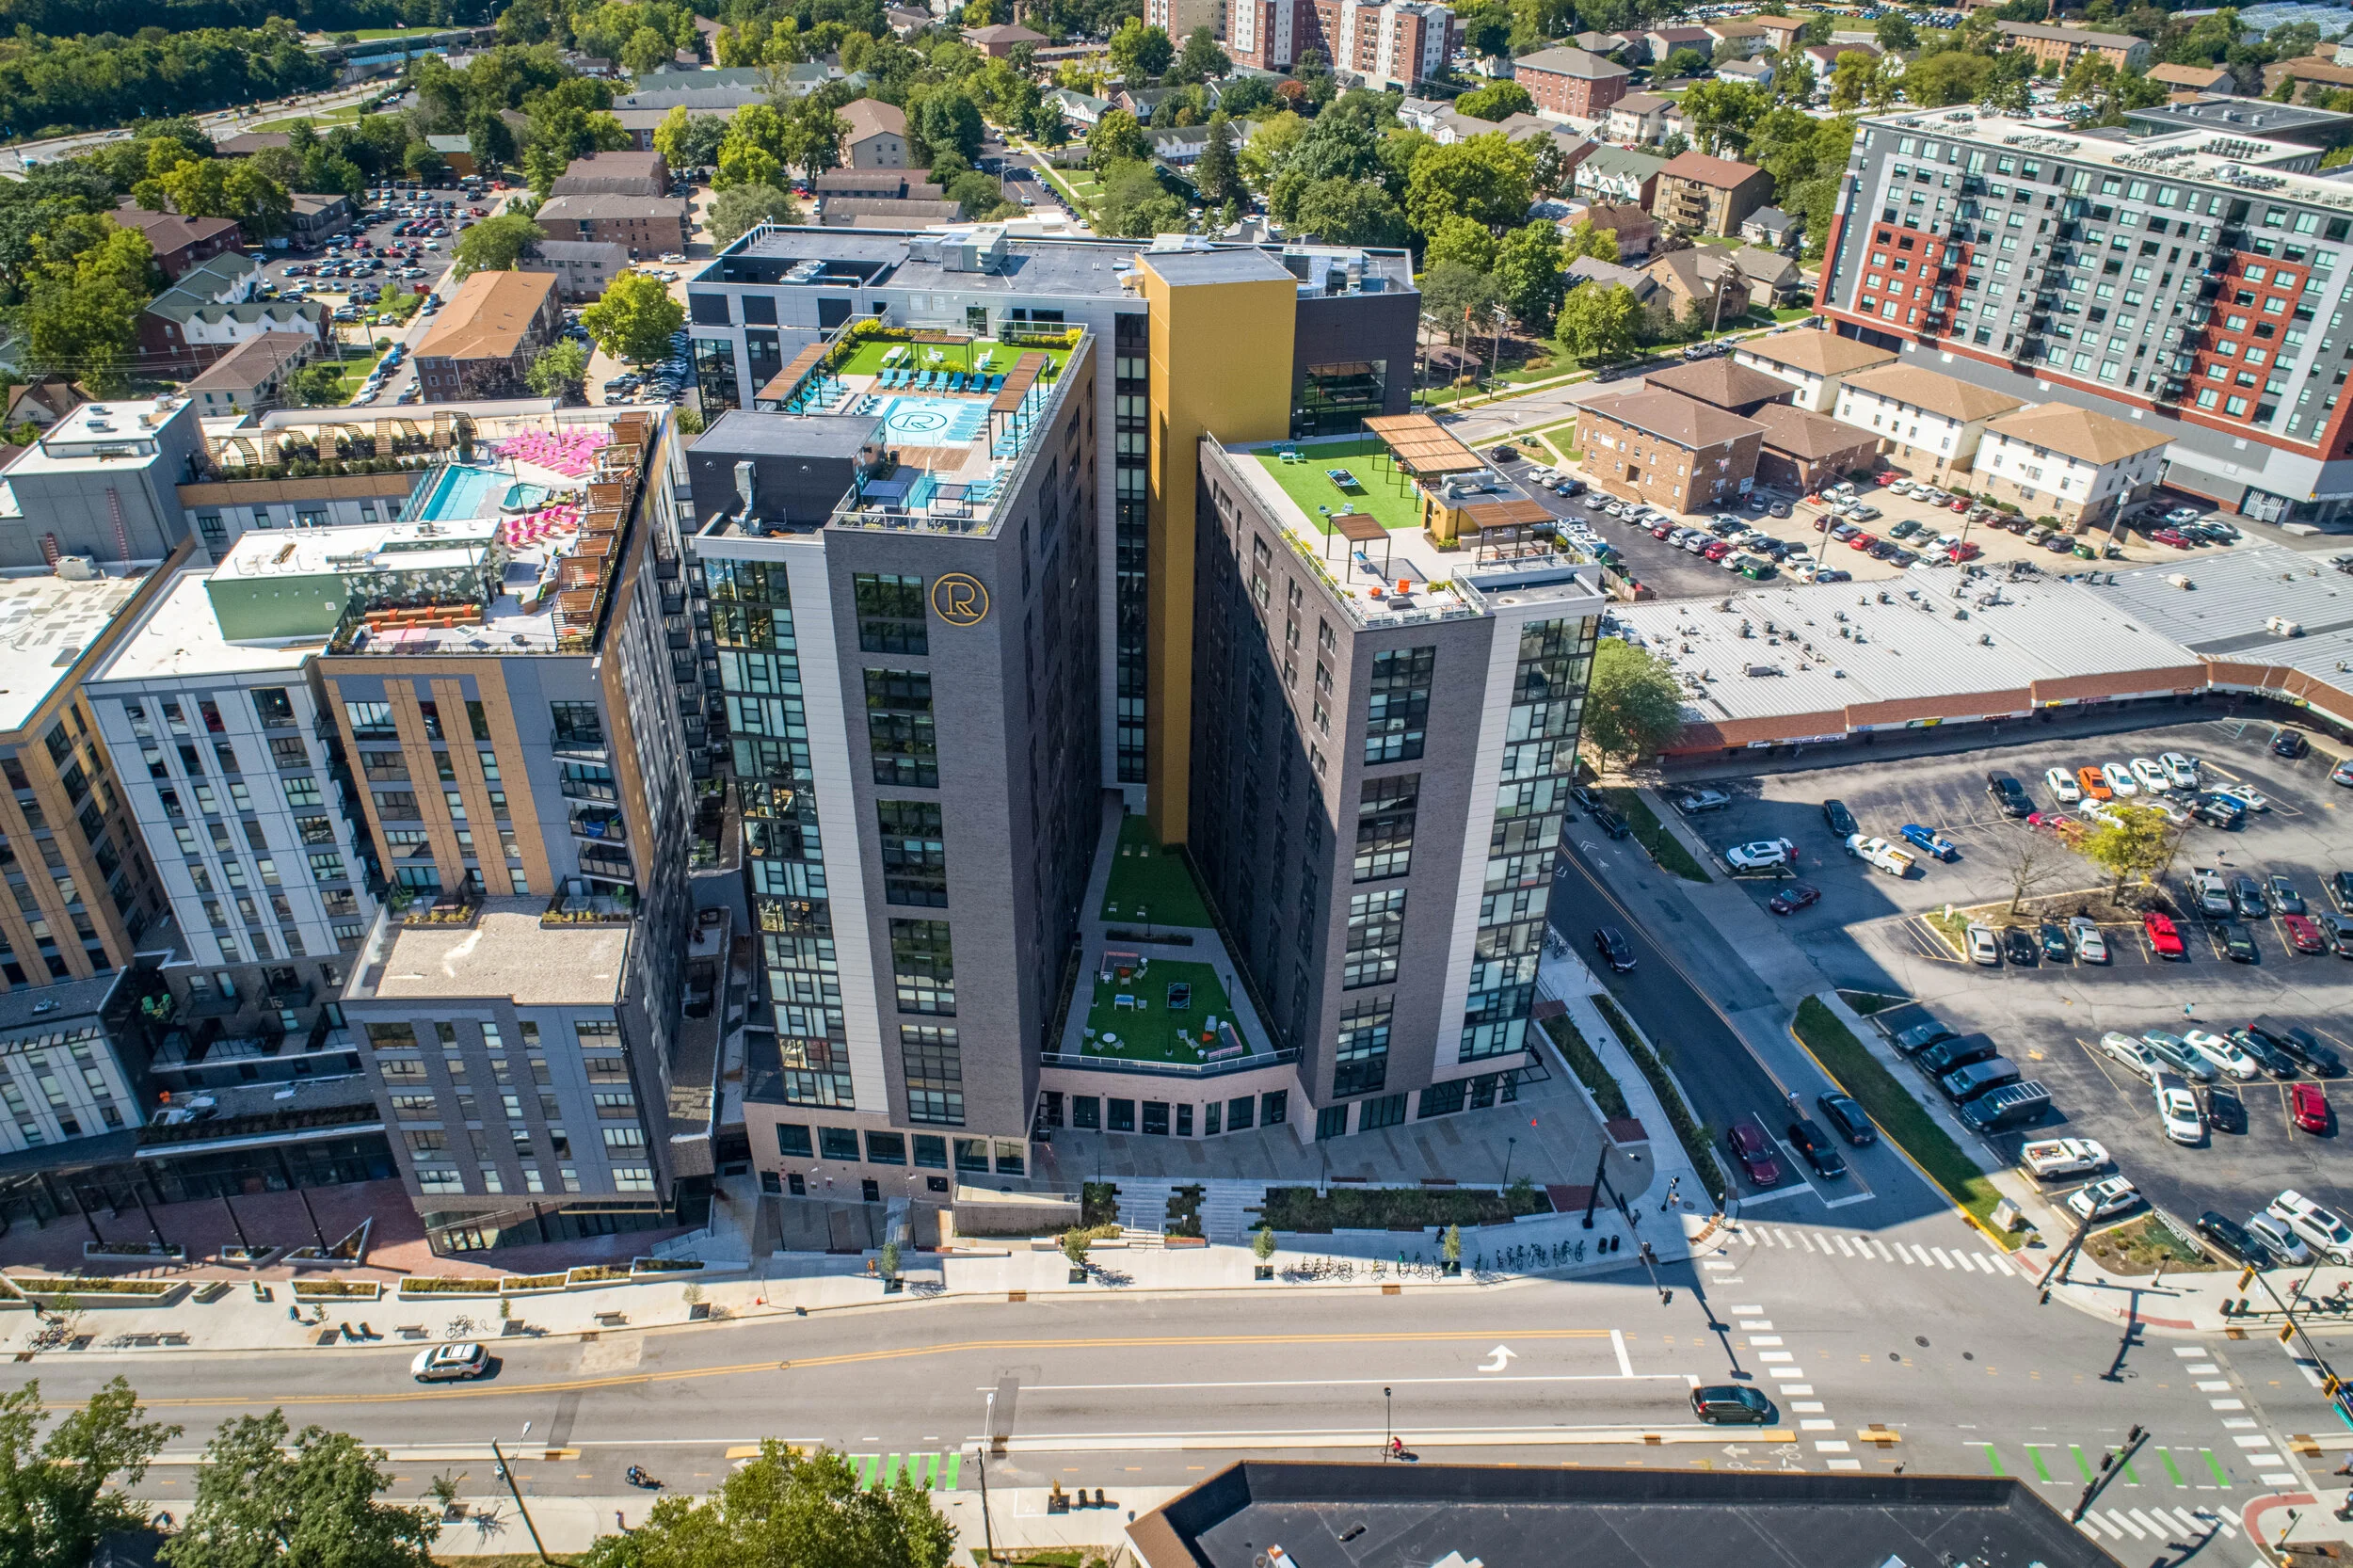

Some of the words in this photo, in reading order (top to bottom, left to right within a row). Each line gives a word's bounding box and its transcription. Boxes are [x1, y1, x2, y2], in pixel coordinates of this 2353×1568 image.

[897, 415, 934, 428] R
[943, 581, 979, 616] R
[2154, 1211, 2186, 1241] CHAUNCEY
[2186, 1240, 2200, 1255] HILL
